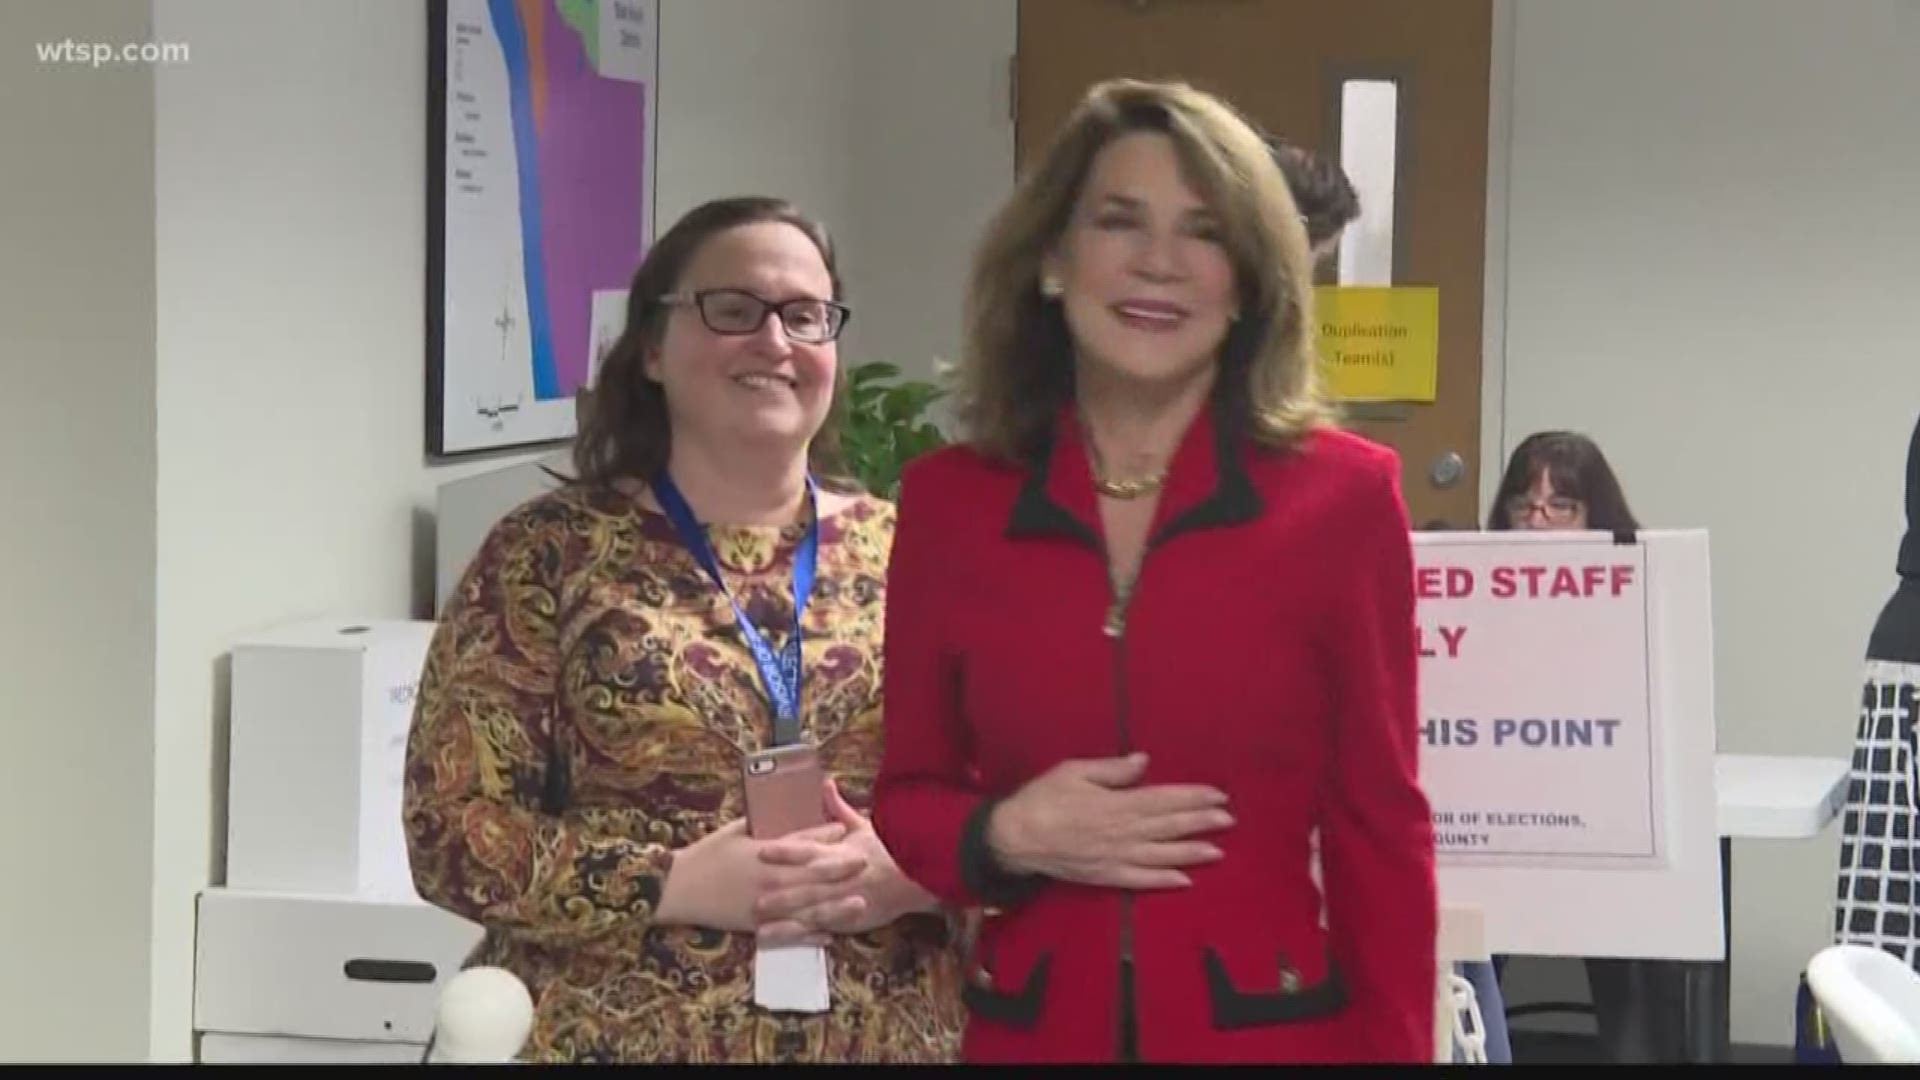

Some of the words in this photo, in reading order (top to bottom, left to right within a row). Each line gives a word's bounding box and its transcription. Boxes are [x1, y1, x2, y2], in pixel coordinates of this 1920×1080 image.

[1416, 567, 1475, 600] ED
[1490, 565, 1636, 599] STAFF
[1493, 717, 1622, 747] POINT
[1459, 812, 1481, 826] OF
[1486, 812, 1587, 828] ELECTIONS,
